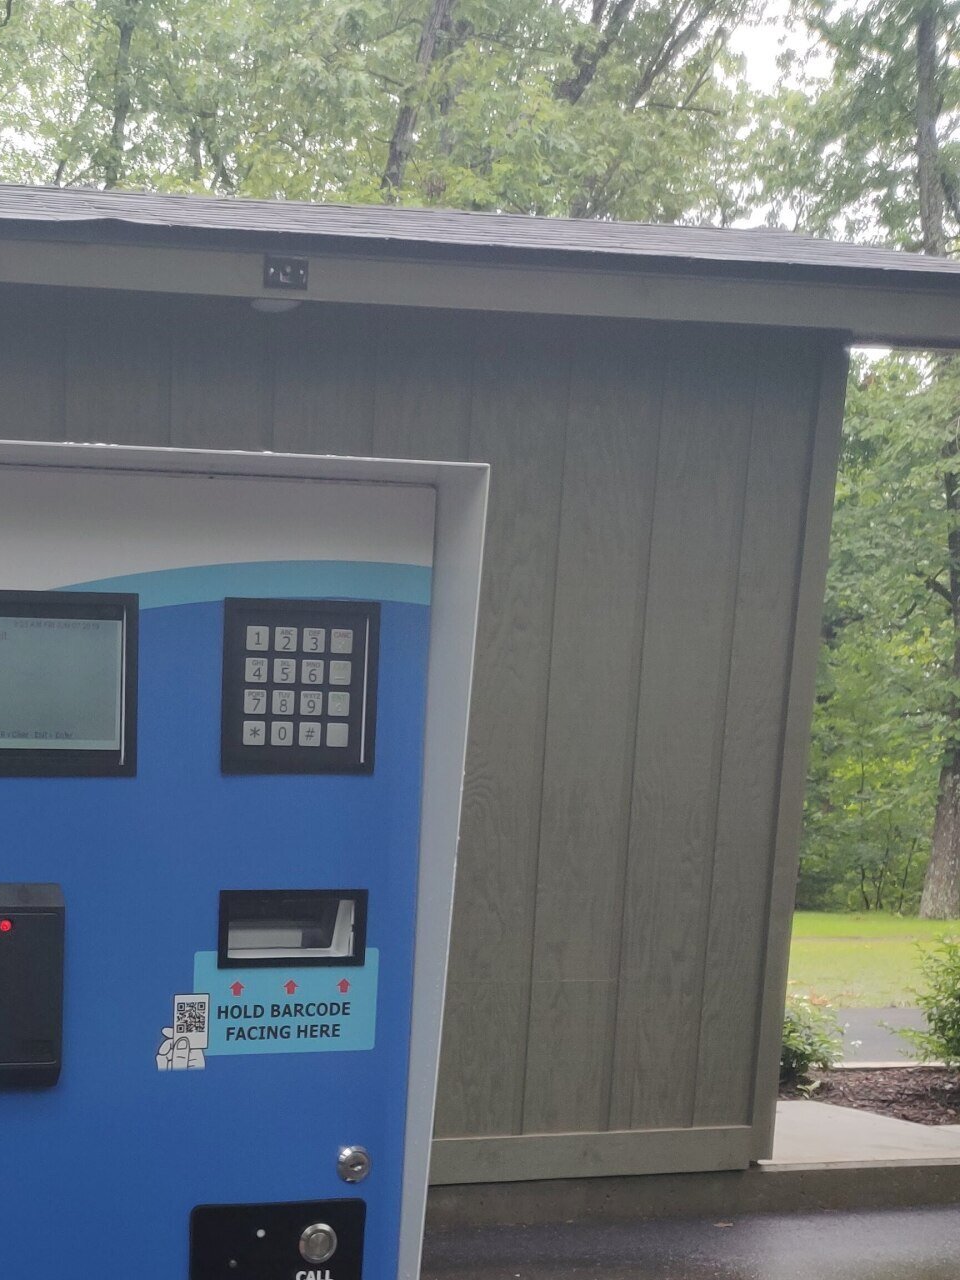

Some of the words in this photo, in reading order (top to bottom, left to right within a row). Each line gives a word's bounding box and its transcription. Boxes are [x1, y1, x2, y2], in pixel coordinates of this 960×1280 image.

[255, 631, 262, 645] 1
[282, 636, 291, 650] 2
[310, 637, 318, 651] 3
[253, 667, 262, 680] 4
[281, 667, 289, 681] 5
[308, 669, 317, 682] 6
[252, 698, 261, 712] 7
[280, 699, 288, 712] 8
[307, 700, 316, 713] 9
[278, 726, 287, 740] 0
[218, 1004, 265, 1020] HOLD
[270, 1002, 351, 1018] BARCODE
[226, 1025, 291, 1041] FACING
[297, 1024, 341, 1039] HERE
